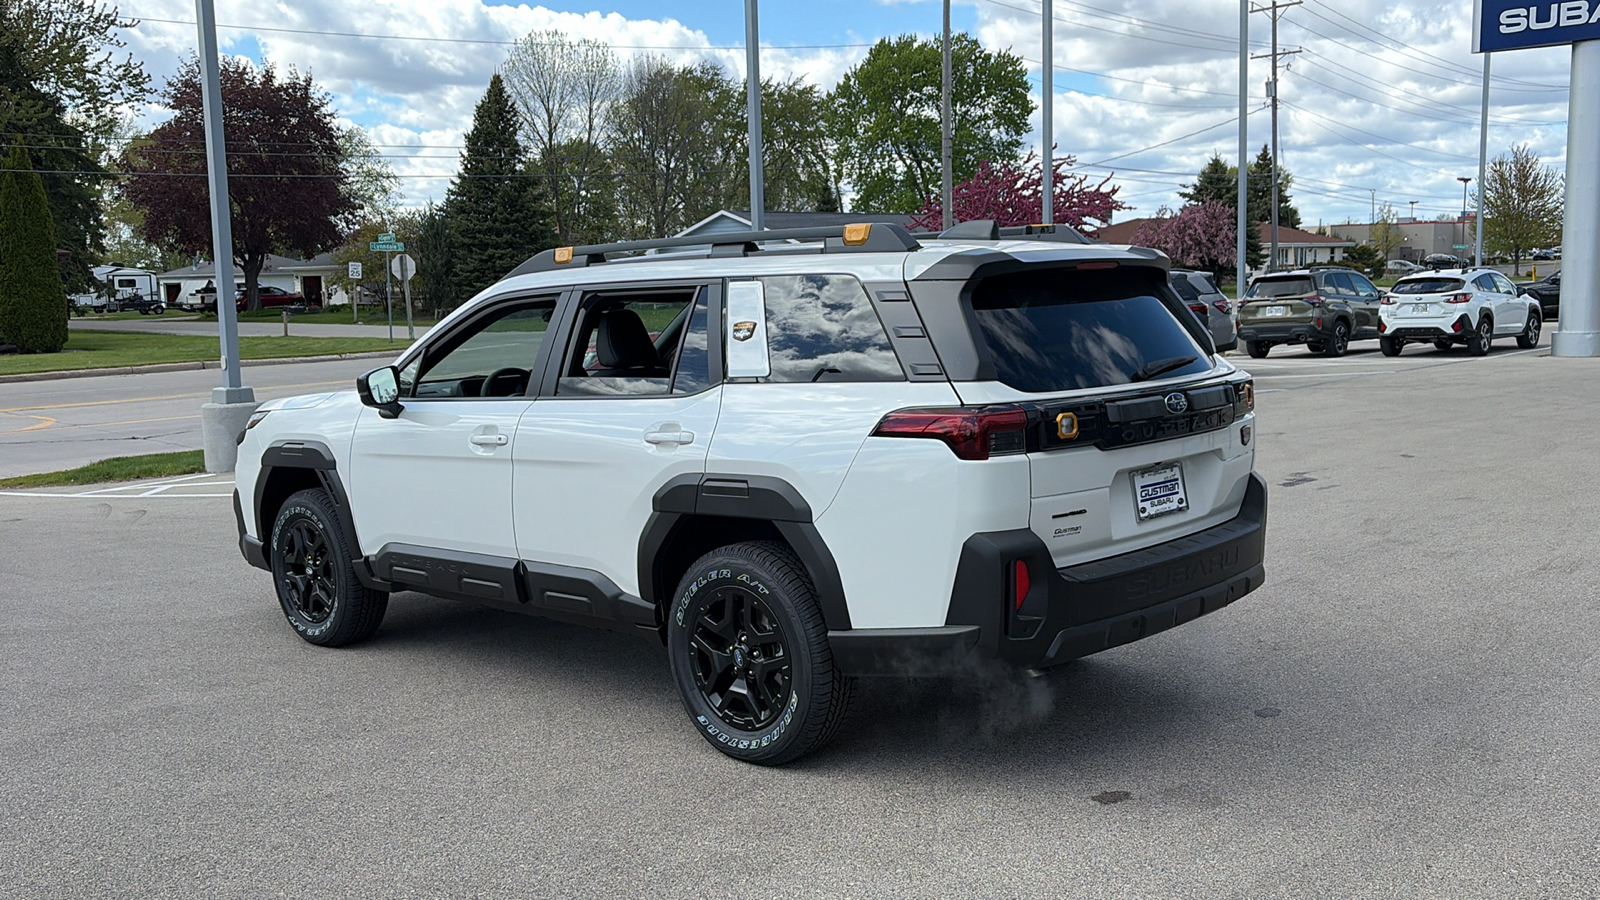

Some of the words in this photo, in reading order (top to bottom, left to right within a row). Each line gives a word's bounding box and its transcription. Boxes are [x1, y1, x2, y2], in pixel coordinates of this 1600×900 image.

[1122, 408, 1227, 441] OUTBACK
[1150, 497, 1174, 508] SUBARU
[390, 555, 469, 575] OUTBACK
[1126, 545, 1239, 600] SUBARU
[675, 569, 732, 627] DUELER
[737, 573, 770, 595] A/T
[697, 690, 799, 750] BRIDGESTONE
